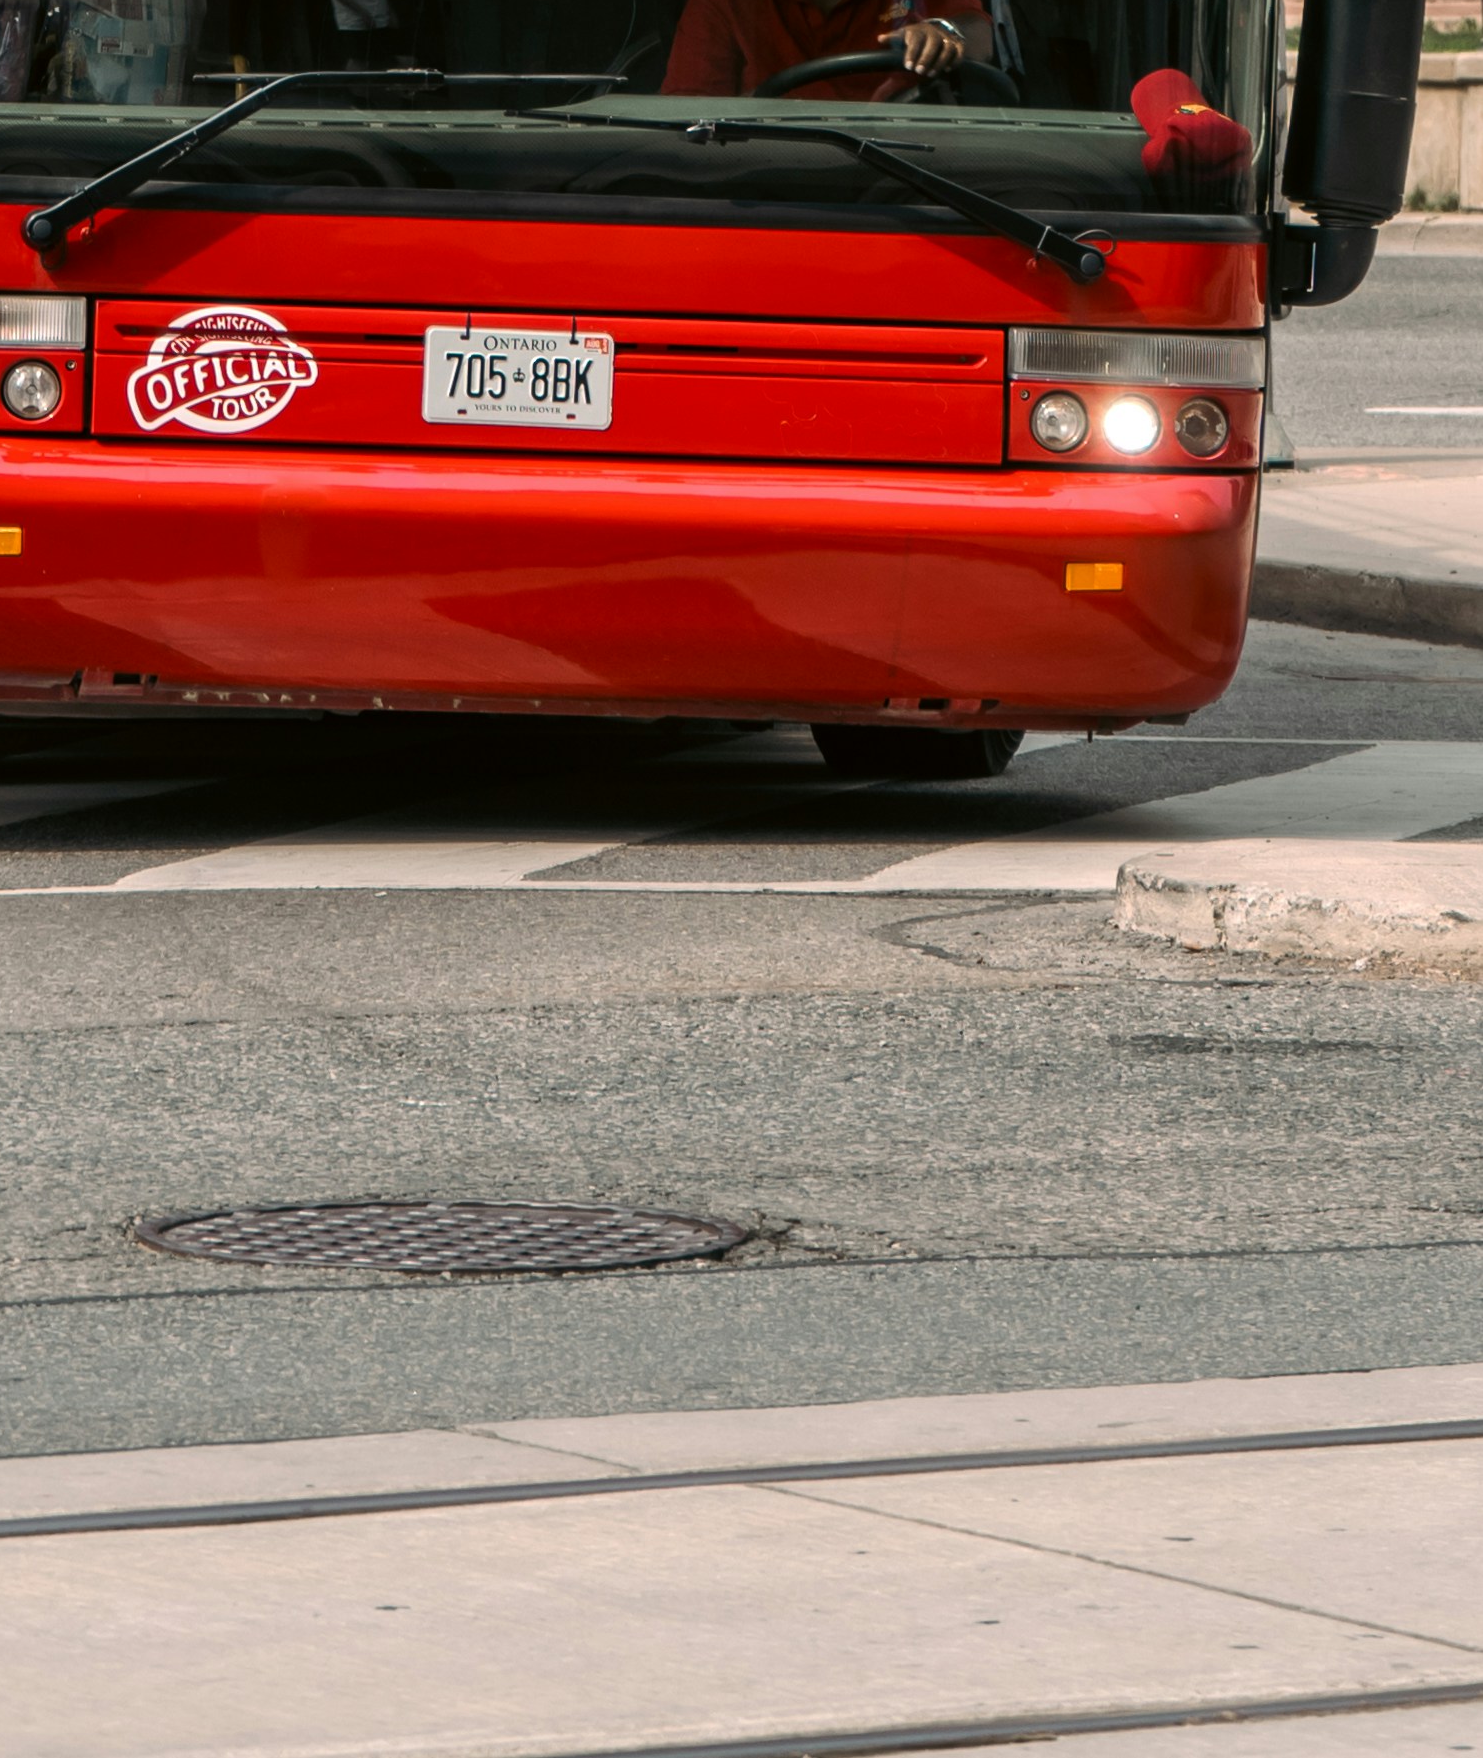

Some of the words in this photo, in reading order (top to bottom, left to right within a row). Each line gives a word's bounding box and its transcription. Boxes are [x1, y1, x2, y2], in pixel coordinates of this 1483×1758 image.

[147, 351, 307, 410] OFFICIAL
[446, 353, 507, 399] 705
[531, 357, 594, 404] 8BK
[211, 385, 277, 420] TOUR
[474, 404, 502, 412] YOURS
[506, 405, 517, 413] TO
[519, 406, 561, 415] DISCOVER
